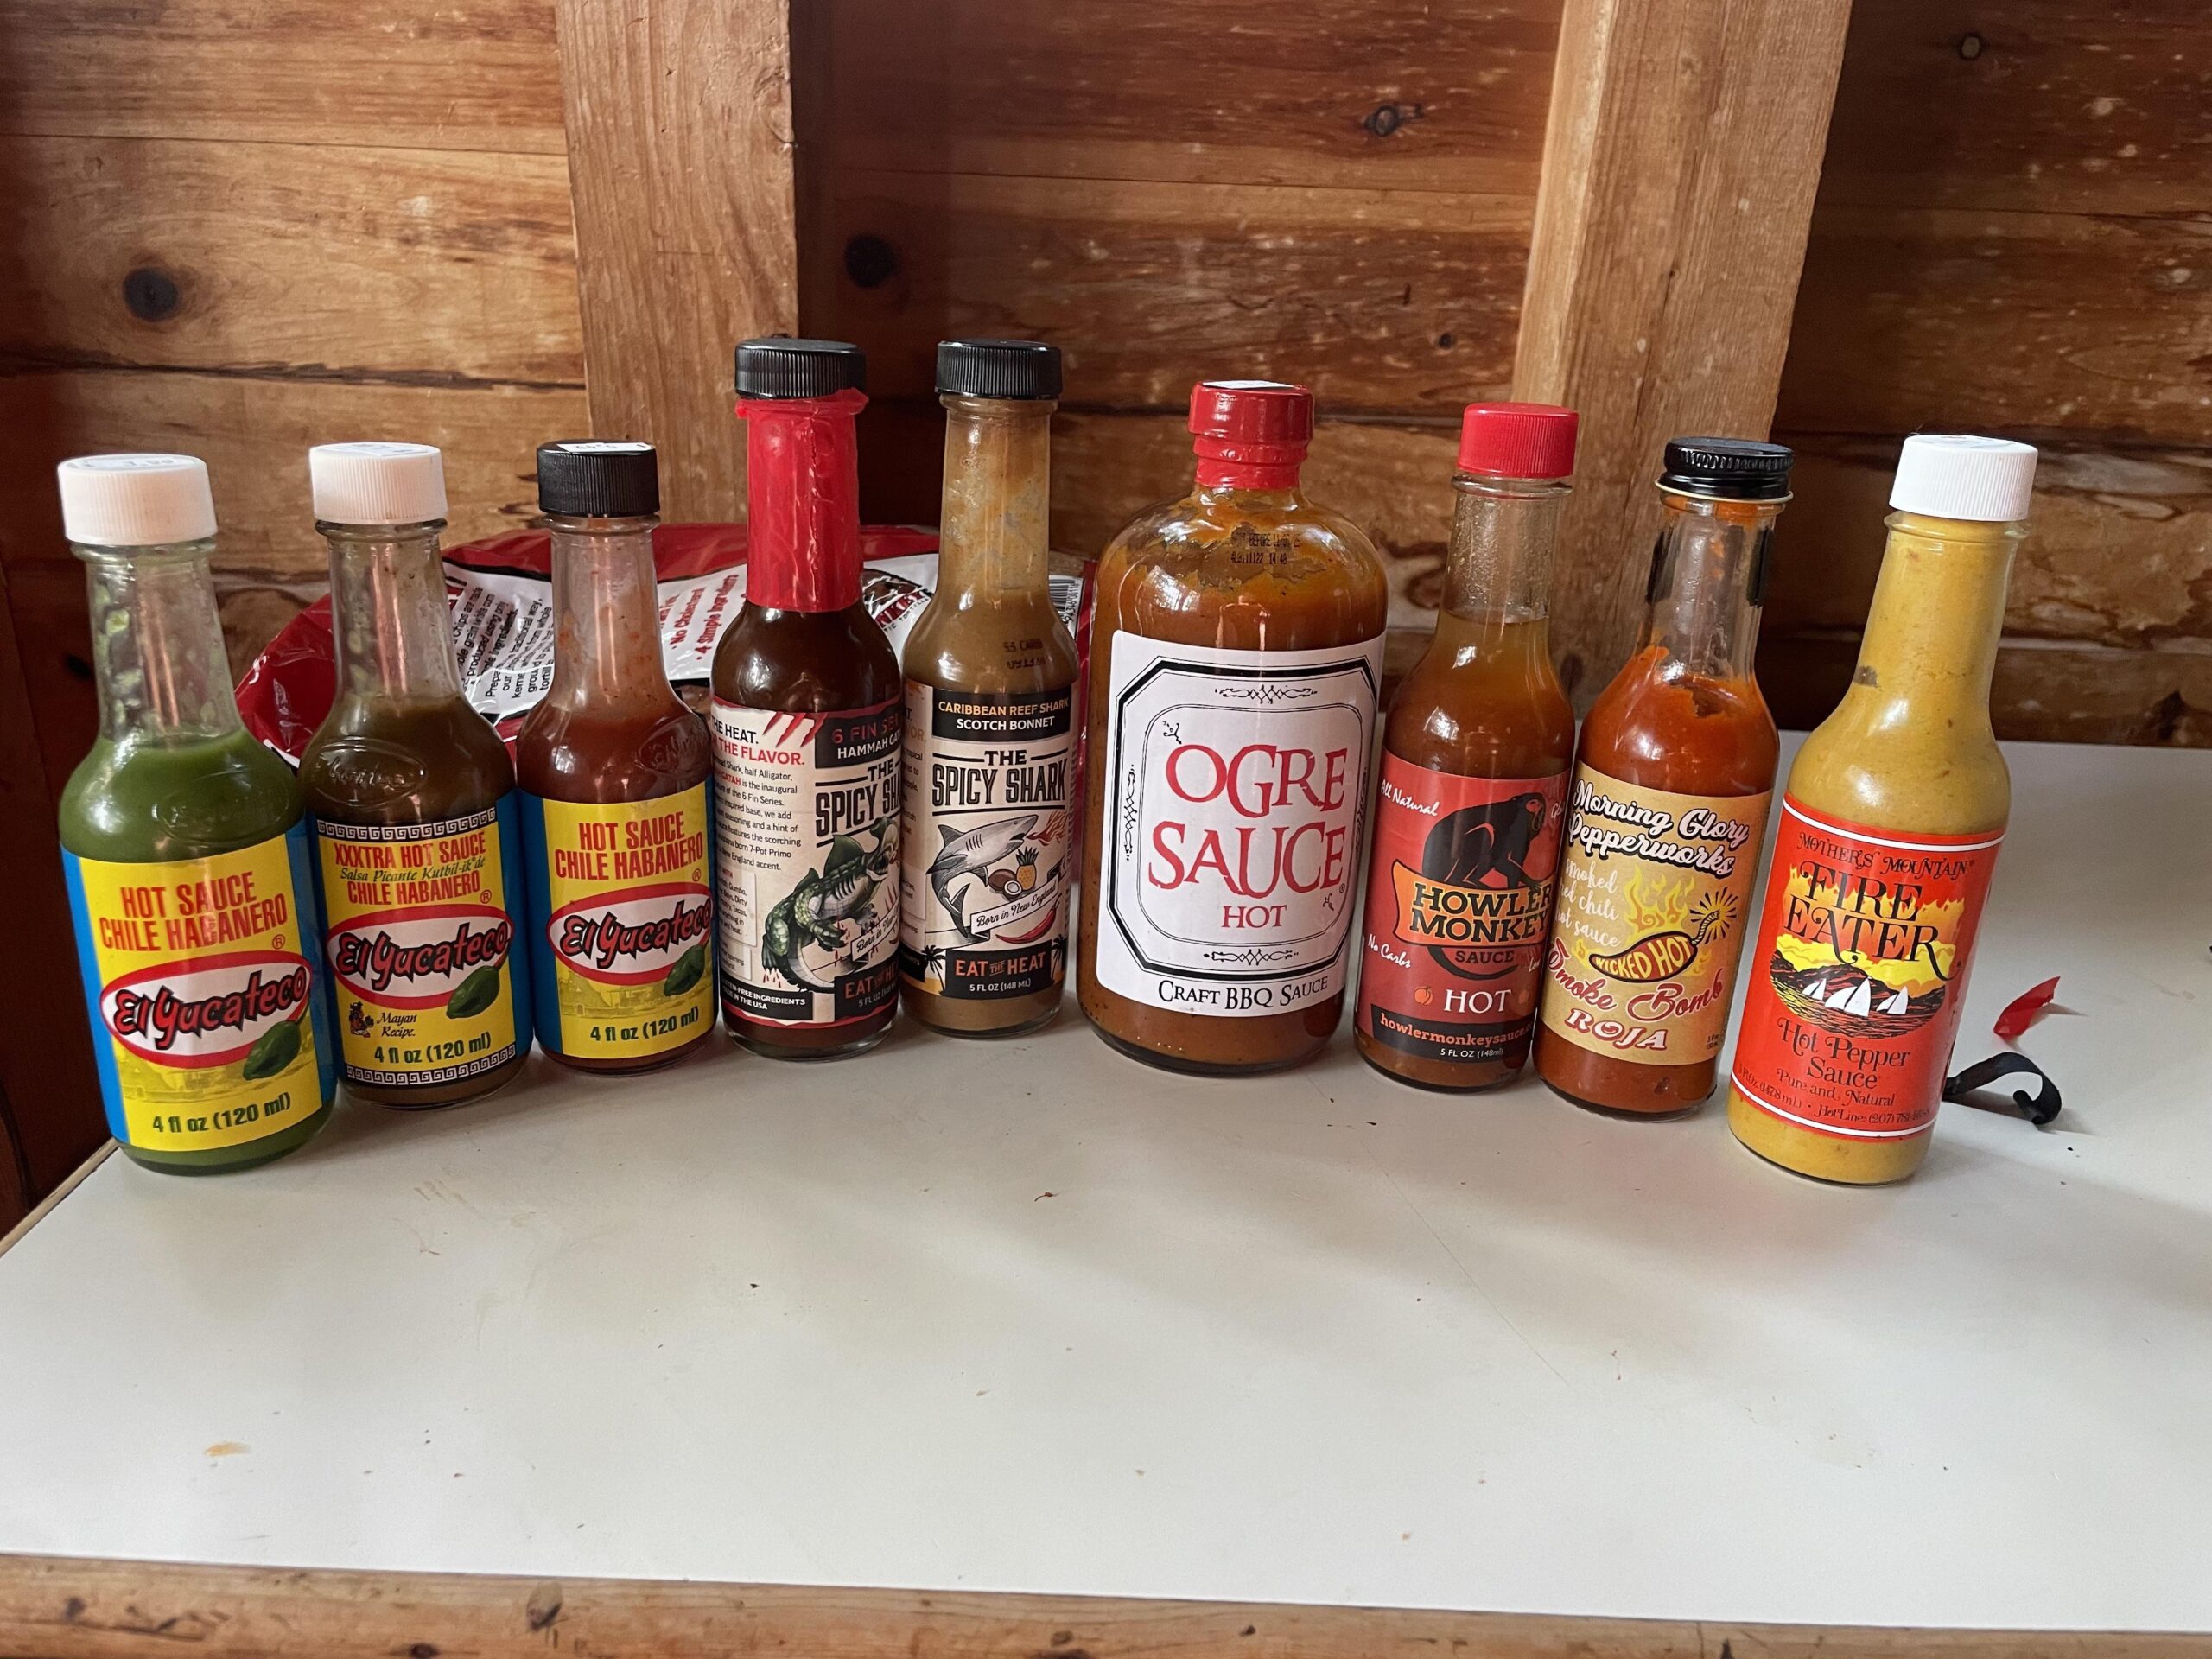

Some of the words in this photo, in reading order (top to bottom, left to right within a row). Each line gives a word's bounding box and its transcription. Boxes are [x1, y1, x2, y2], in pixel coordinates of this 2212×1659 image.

[670, 629, 688, 645] No
[697, 613, 722, 645] Simple
[467, 634, 490, 677] produced
[502, 673, 513, 691] our
[938, 701, 1007, 716] CARIBBEAN
[1009, 704, 1037, 715] REEF
[1039, 698, 1069, 714] SHARK
[725, 723, 759, 744] HEAT.
[832, 728, 844, 744] 6
[850, 722, 877, 741] FIN
[956, 718, 1007, 731] SCOTCH
[1009, 716, 1055, 730] BONNET
[719, 737, 738, 757] THE
[741, 745, 805, 766] FLAVOR.
[837, 737, 888, 759] HAMMAH
[984, 749, 1027, 766] THE
[744, 766, 757, 777] half
[867, 757, 893, 782] THE
[932, 763, 998, 807] SPICY
[1005, 759, 1068, 803] SHARK
[1166, 744, 1347, 819] OGRE
[741, 791, 747, 800] 6
[747, 793, 759, 803] Fin
[760, 796, 785, 806] Series.
[748, 782, 760, 791] the
[761, 782, 798, 795] inaugural
[1381, 779, 1391, 798] All
[1393, 788, 1440, 817] Natural
[764, 810, 776, 819] we
[777, 811, 792, 820] add
[816, 784, 878, 837] SPICY
[1573, 779, 1674, 839] Morning
[1678, 808, 1750, 850] Glory
[579, 823, 618, 852] HOT
[626, 810, 684, 849] SAUCE
[752, 821, 765, 830] and
[772, 823, 788, 832] hint
[790, 824, 798, 833] of
[752, 833, 763, 842] the
[764, 836, 801, 848] scorching
[334, 842, 394, 869] XXXTRA
[400, 842, 434, 869] HOT
[439, 831, 486, 864] SAUCE
[555, 849, 609, 880] CHILE
[614, 831, 703, 880] HABANERO
[749, 845, 767, 855] 7-Pot
[768, 848, 791, 858] Primo
[1568, 810, 1736, 879] Pepperworks
[1797, 831, 1879, 870] MOTHER'S
[1880, 856, 1969, 880] MOUNTAIN
[731, 852, 754, 867] England
[756, 861, 782, 871] accent.
[1148, 821, 1346, 899] SAUCE
[340, 867, 369, 881] Salsa
[372, 868, 418, 883] Picante
[347, 880, 391, 906] CHILE
[397, 870, 480, 905] HABANERO
[1565, 860, 1618, 895] smoked
[121, 887, 166, 919] HOT
[176, 871, 257, 916] SAUCE
[1412, 882, 1552, 918] HOWLER
[1800, 860, 1923, 922] FIRE
[976, 914, 999, 927] Born
[1001, 910, 1009, 921] in
[1010, 902, 1030, 917] New
[1221, 905, 1287, 929] HOT
[1579, 893, 1619, 921] chili
[99, 917, 161, 951] CHILE
[167, 893, 288, 950] HABANERO
[1409, 907, 1548, 944] MONKEY
[1573, 921, 1621, 947] sauce
[1368, 933, 1379, 952] No
[1380, 943, 1412, 969] Carbs
[1783, 894, 1960, 981] EATER
[956, 959, 988, 976] EAT
[989, 962, 1006, 974] THE
[1007, 952, 1046, 975] HEAT
[1454, 950, 1515, 965] SAUCE
[1595, 950, 1652, 980] WICKED
[1646, 936, 1691, 977] HOT
[844, 976, 874, 999] EAT
[969, 983, 976, 992] 5
[976, 983, 988, 992] FL
[988, 983, 999, 992] OZ
[1001, 982, 1016, 993] (148
[1018, 979, 1031, 988] ML)
[1548, 937, 1617, 1012] Smoke
[1627, 967, 1723, 1022] Bomb
[740, 995, 753, 1007] THE
[753, 1000, 768, 1010] USA
[753, 993, 806, 1006] INGREDIENTS
[1224, 986, 1273, 1011] BBQ
[1443, 988, 1512, 1014] HOT
[377, 1012, 417, 1027] Mayan
[590, 1027, 601, 1040] 4
[605, 1027, 617, 1041] fl
[621, 1027, 638, 1040] oz
[642, 1015, 677, 1040] (120
[681, 1006, 699, 1028] ml)
[1564, 1007, 1669, 1052] ROJA
[374, 1047, 384, 1064] 4
[388, 1046, 399, 1064] fl
[404, 1049, 422, 1063] oz
[427, 1039, 464, 1064] (120
[468, 1032, 491, 1052] ml)
[1440, 1047, 1446, 1056] 5
[1447, 1049, 1458, 1058] FL
[1477, 1047, 1504, 1059] (148ml)
[1777, 1018, 1819, 1057] Hot
[1825, 1037, 1910, 1071] Pepper
[1807, 1057, 1878, 1089] Sauce
[1777, 1068, 1807, 1091] Pure
[1810, 1085, 1840, 1101] and
[1842, 1090, 1895, 1107] Natural
[153, 1116, 164, 1133] 4
[169, 1116, 182, 1133] fl
[188, 1116, 208, 1132] oz
[213, 1104, 259, 1130] (120
[264, 1092, 291, 1117] ml)
[1869, 1112, 1894, 1124] (207)
